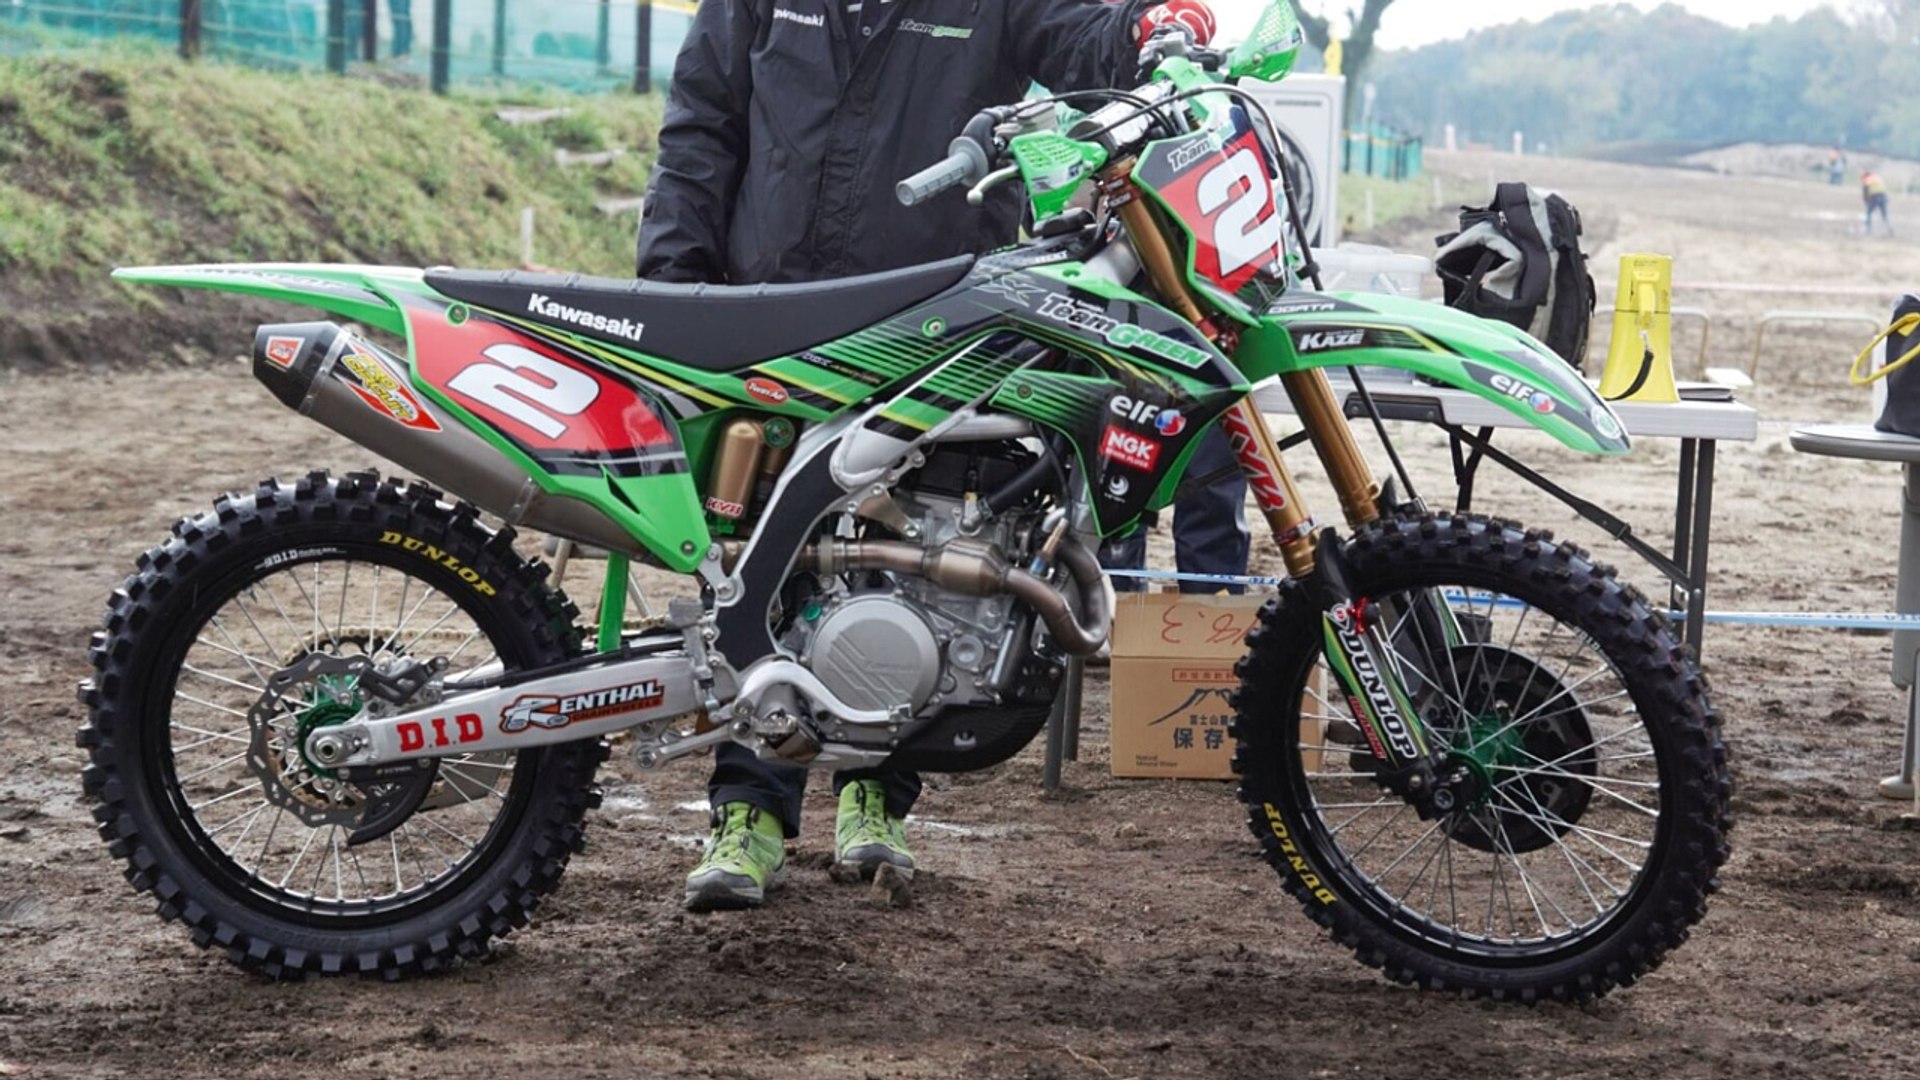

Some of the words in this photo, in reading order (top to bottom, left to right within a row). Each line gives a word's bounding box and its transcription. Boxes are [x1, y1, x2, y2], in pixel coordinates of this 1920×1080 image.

[1196, 147, 1280, 279] 2
[527, 292, 645, 342] Kawasaki
[1298, 331, 1365, 351] KAZE
[445, 342, 601, 441] 2
[1109, 395, 1160, 425] elf
[1489, 374, 1533, 401] elf
[1107, 430, 1155, 461] NGK
[379, 530, 497, 598] DUNLOP
[1339, 629, 1418, 759] DUNLOP
[397, 713, 484, 752] D.I.D
[1263, 803, 1338, 905] DUNLOP
